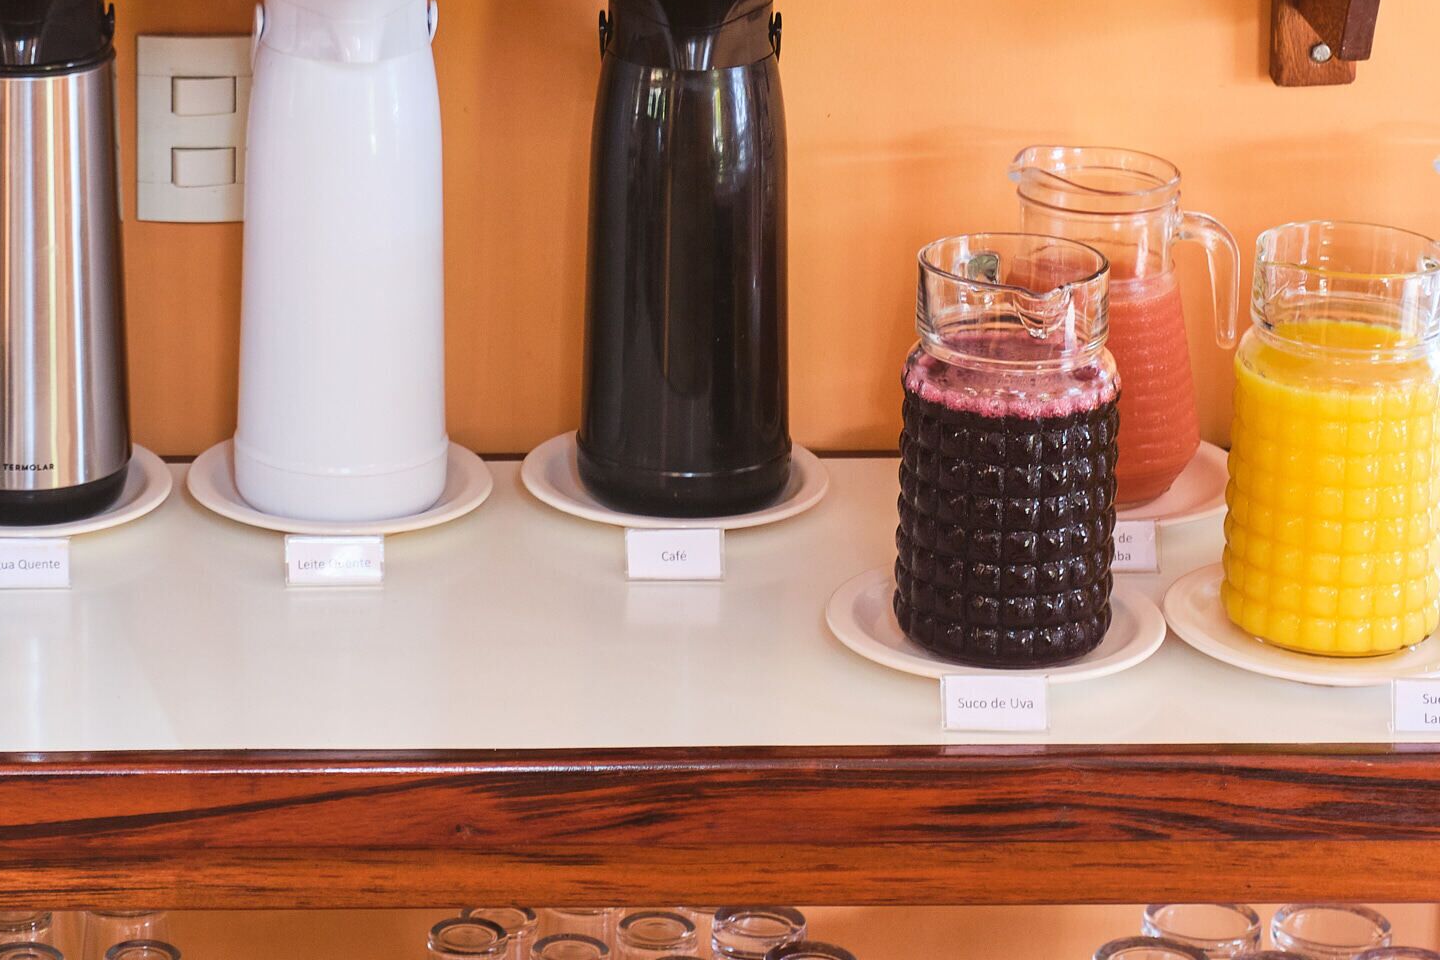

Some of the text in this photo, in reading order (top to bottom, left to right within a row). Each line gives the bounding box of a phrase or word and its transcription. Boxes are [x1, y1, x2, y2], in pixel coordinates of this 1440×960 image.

[3, 463, 54, 471] TERMOLAR
[1118, 532, 1133, 543] de
[661, 550, 687, 562] Café
[17, 558, 61, 571] Quente
[298, 559, 324, 570] Leite
[958, 697, 1034, 709] Suco de Uva
